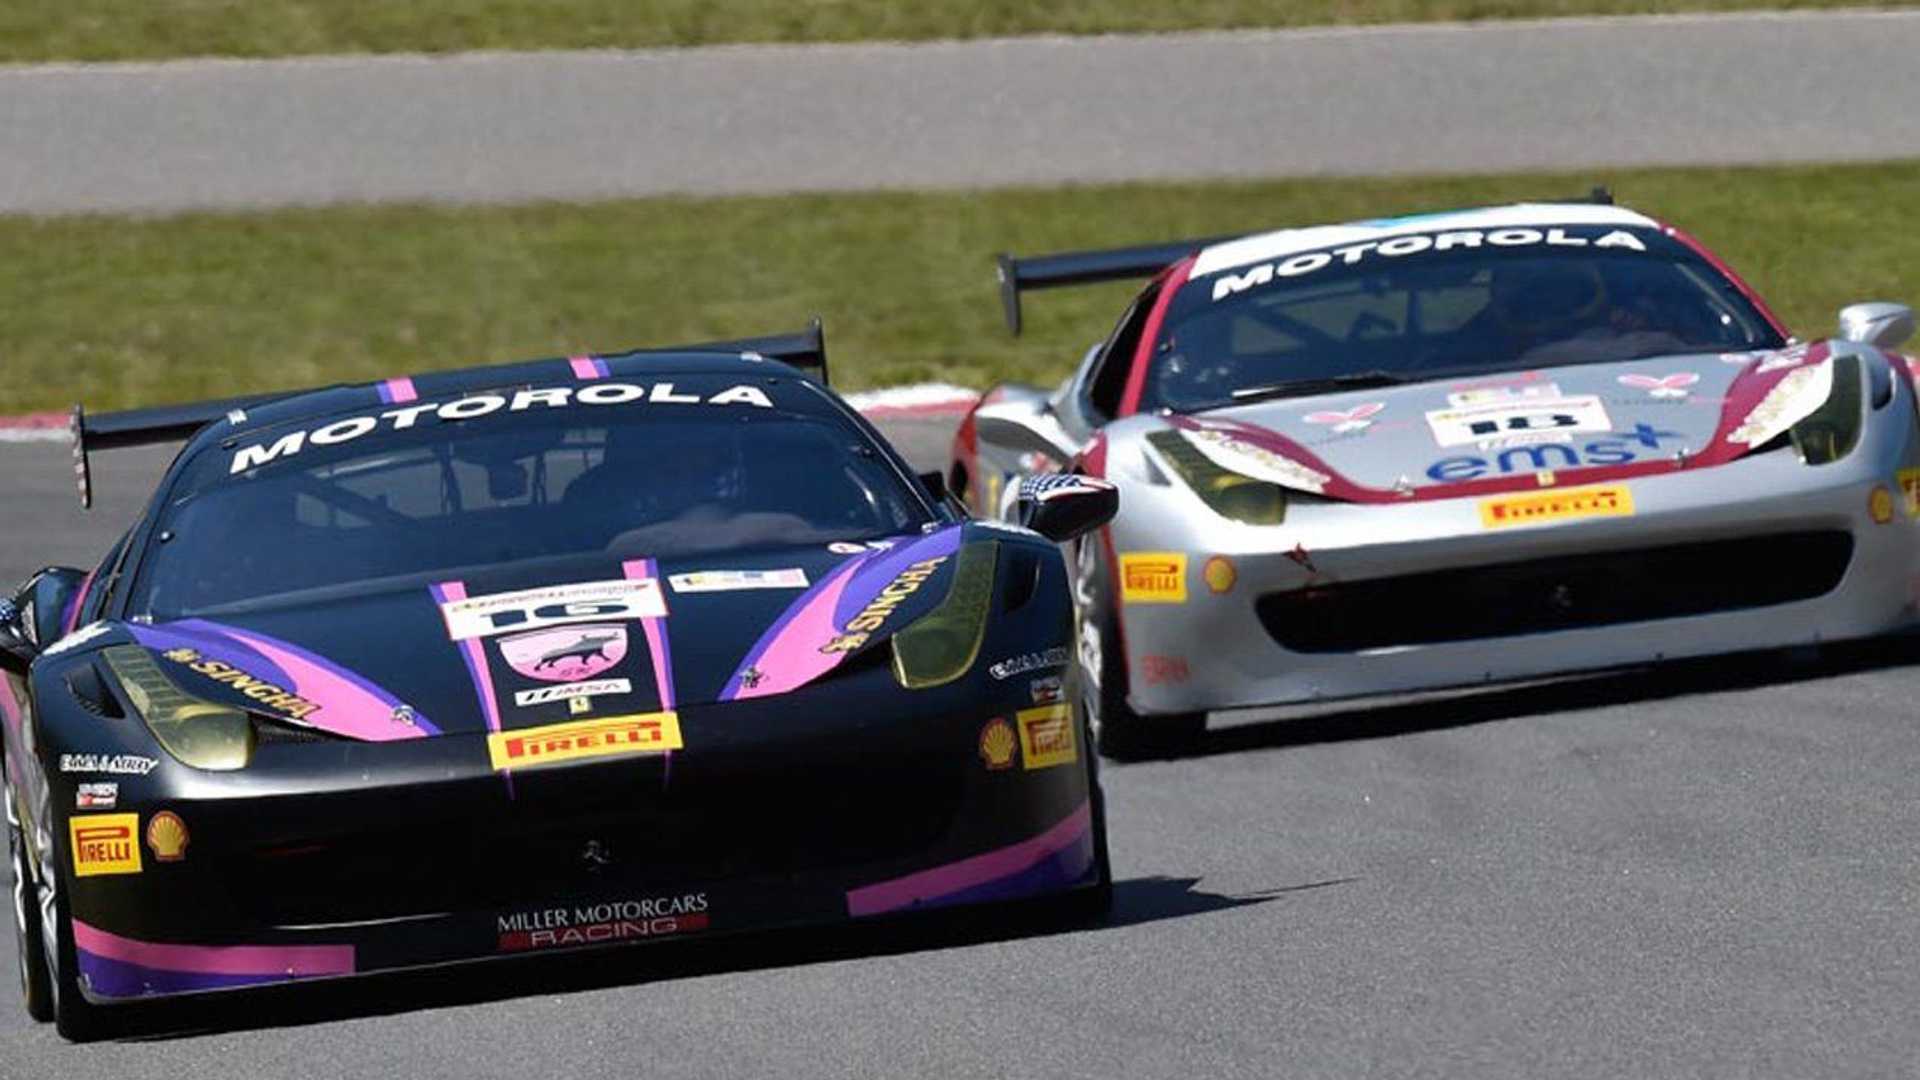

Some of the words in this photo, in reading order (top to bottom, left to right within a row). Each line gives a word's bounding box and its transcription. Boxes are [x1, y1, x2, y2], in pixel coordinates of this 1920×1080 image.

[1212, 228, 1647, 301] MOTOROLA
[229, 382, 774, 475] MOTOROLA
[190, 660, 321, 719] SINGHA
[505, 719, 662, 760] PIRELLI
[74, 825, 131, 864] PIRELLI
[498, 907, 568, 932] MILLER
[574, 893, 709, 924] MOTORCARS
[531, 917, 677, 947] RACING
